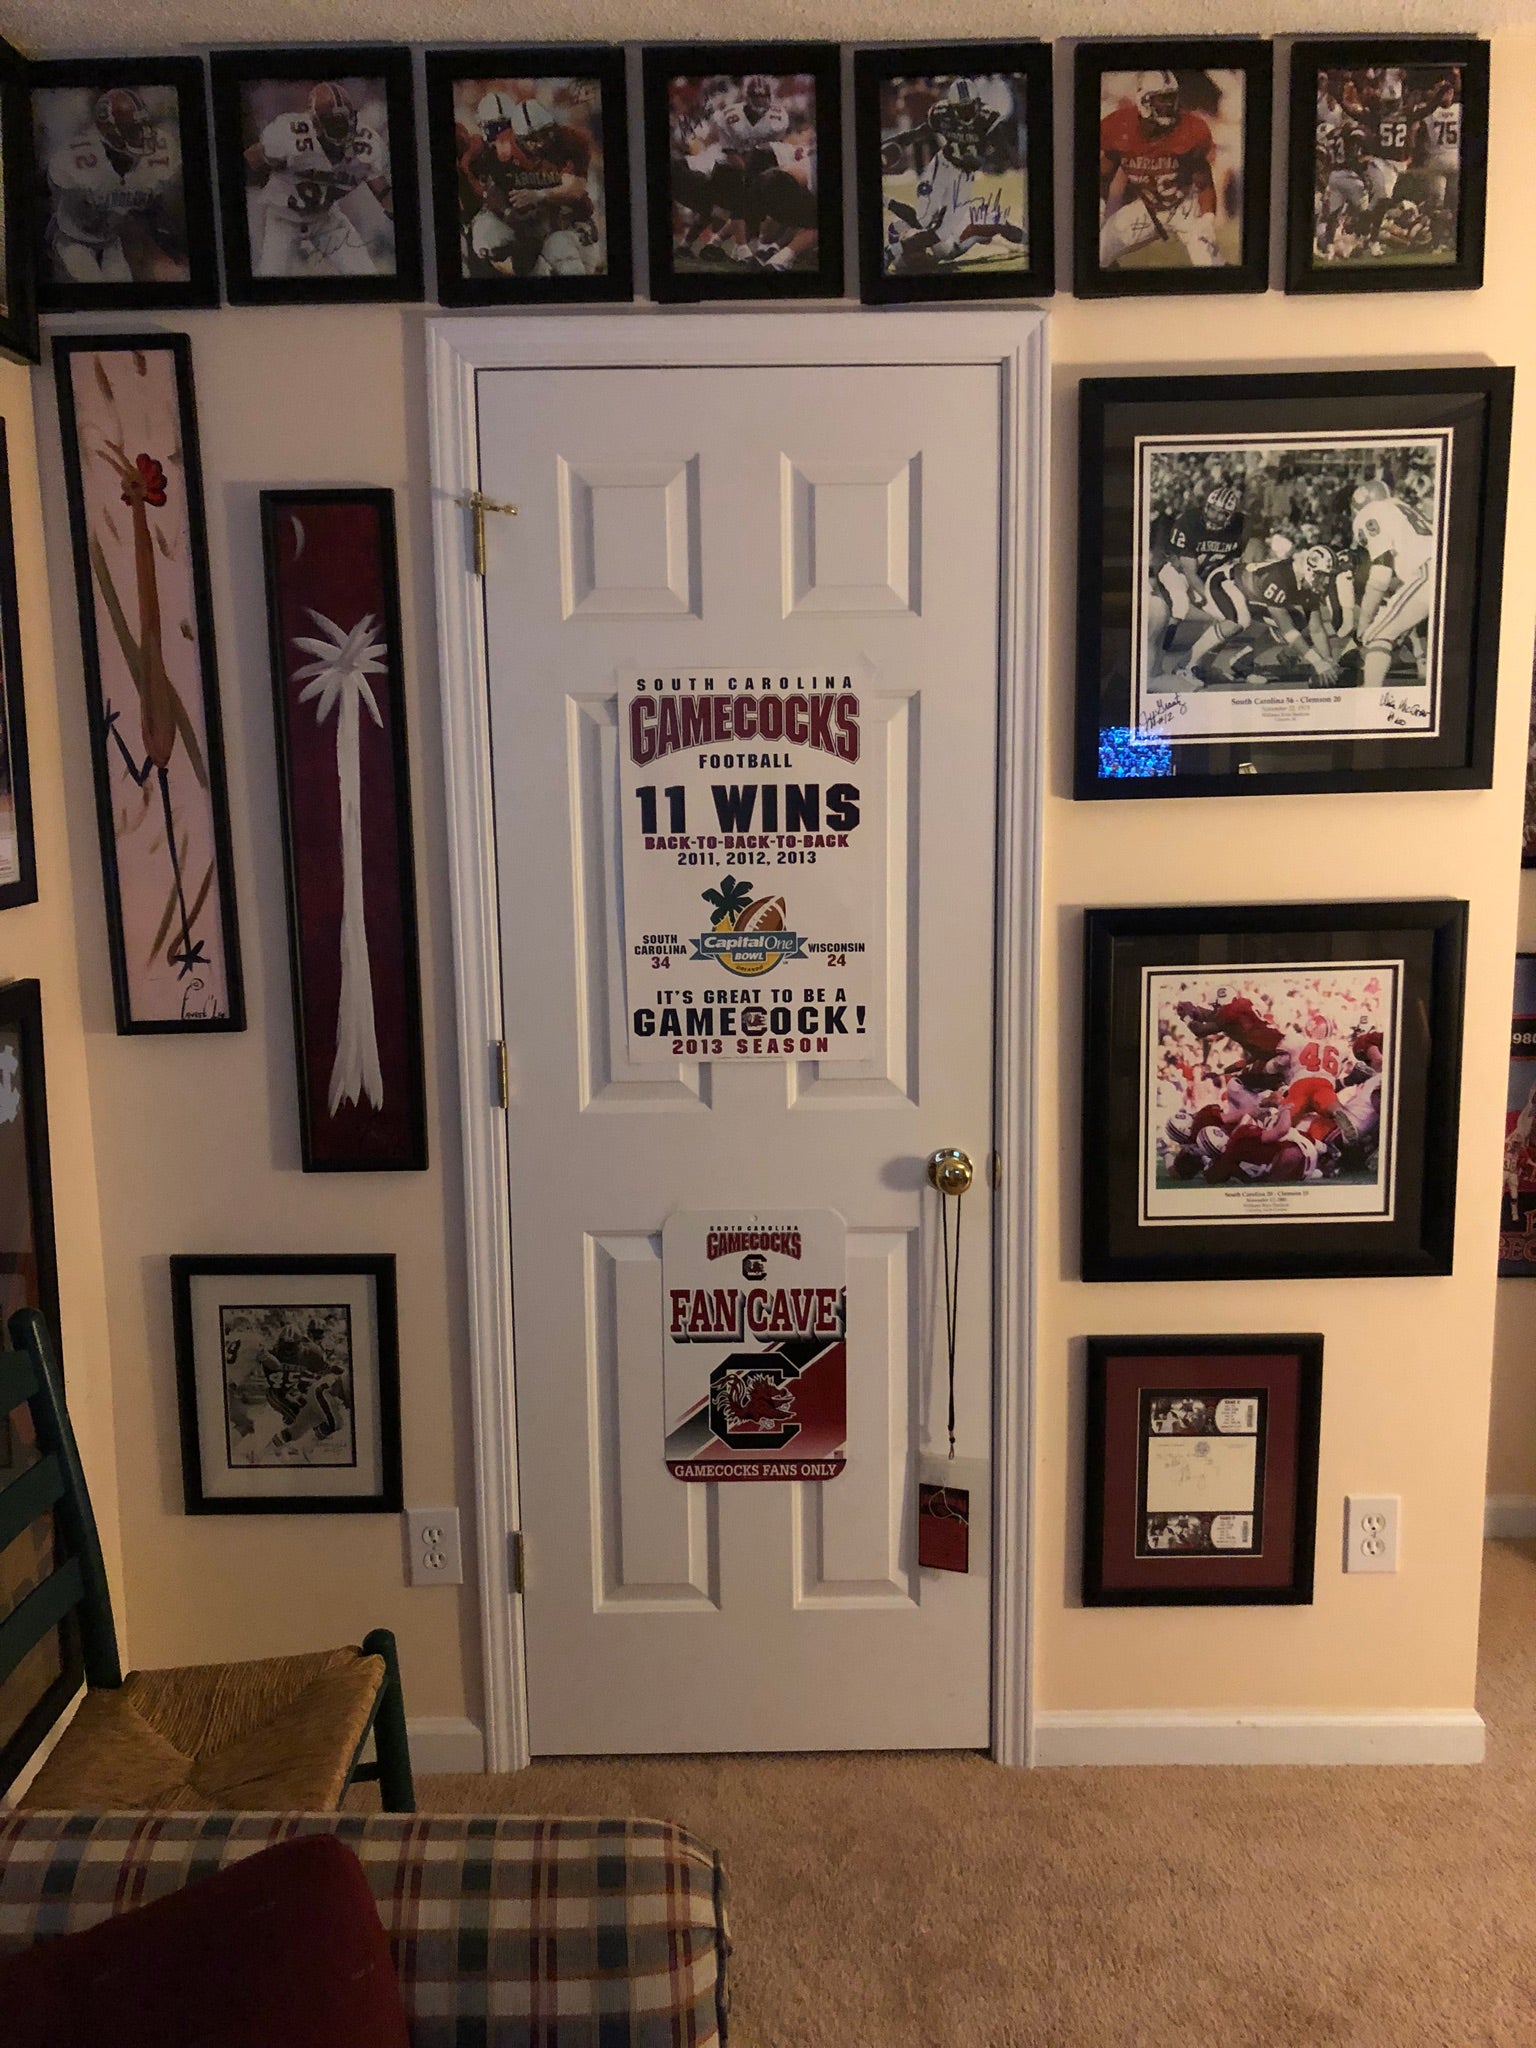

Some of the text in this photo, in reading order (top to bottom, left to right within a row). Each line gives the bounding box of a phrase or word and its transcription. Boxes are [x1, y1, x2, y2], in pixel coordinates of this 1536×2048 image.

[1379, 122, 1408, 148] 52
[1433, 121, 1458, 146] 75
[1170, 528, 1186, 549] 12
[637, 676, 851, 691] SOUTH CAROLINA
[1231, 697, 1253, 705] South
[1254, 697, 1284, 705] Carolina
[1300, 696, 1332, 704] Clemson
[629, 693, 860, 767] GAMECOCKS
[699, 753, 792, 769] FOOTBALL
[636, 784, 860, 834] 11 WINS
[645, 834, 849, 850] BACK-TO-BACK-TO-BACK
[678, 851, 816, 866] 2011, 2012, 2013
[643, 935, 677, 944] SOUTH
[634, 945, 686, 955] CAROLINA
[735, 952, 764, 960] BOWL
[808, 943, 865, 953] WISCONSIN
[651, 957, 670, 969] 34
[828, 954, 846, 967] 24
[657, 988, 846, 1004] IT'S GREAT TO BE A
[672, 1037, 828, 1055] 2013 SEASON
[1298, 1042, 1340, 1076] 46
[707, 1232, 801, 1261] GAMECOCKS
[670, 1288, 840, 1338] FAN CAVE
[674, 1463, 837, 1477] GAMECOCKS FANS ONLY
